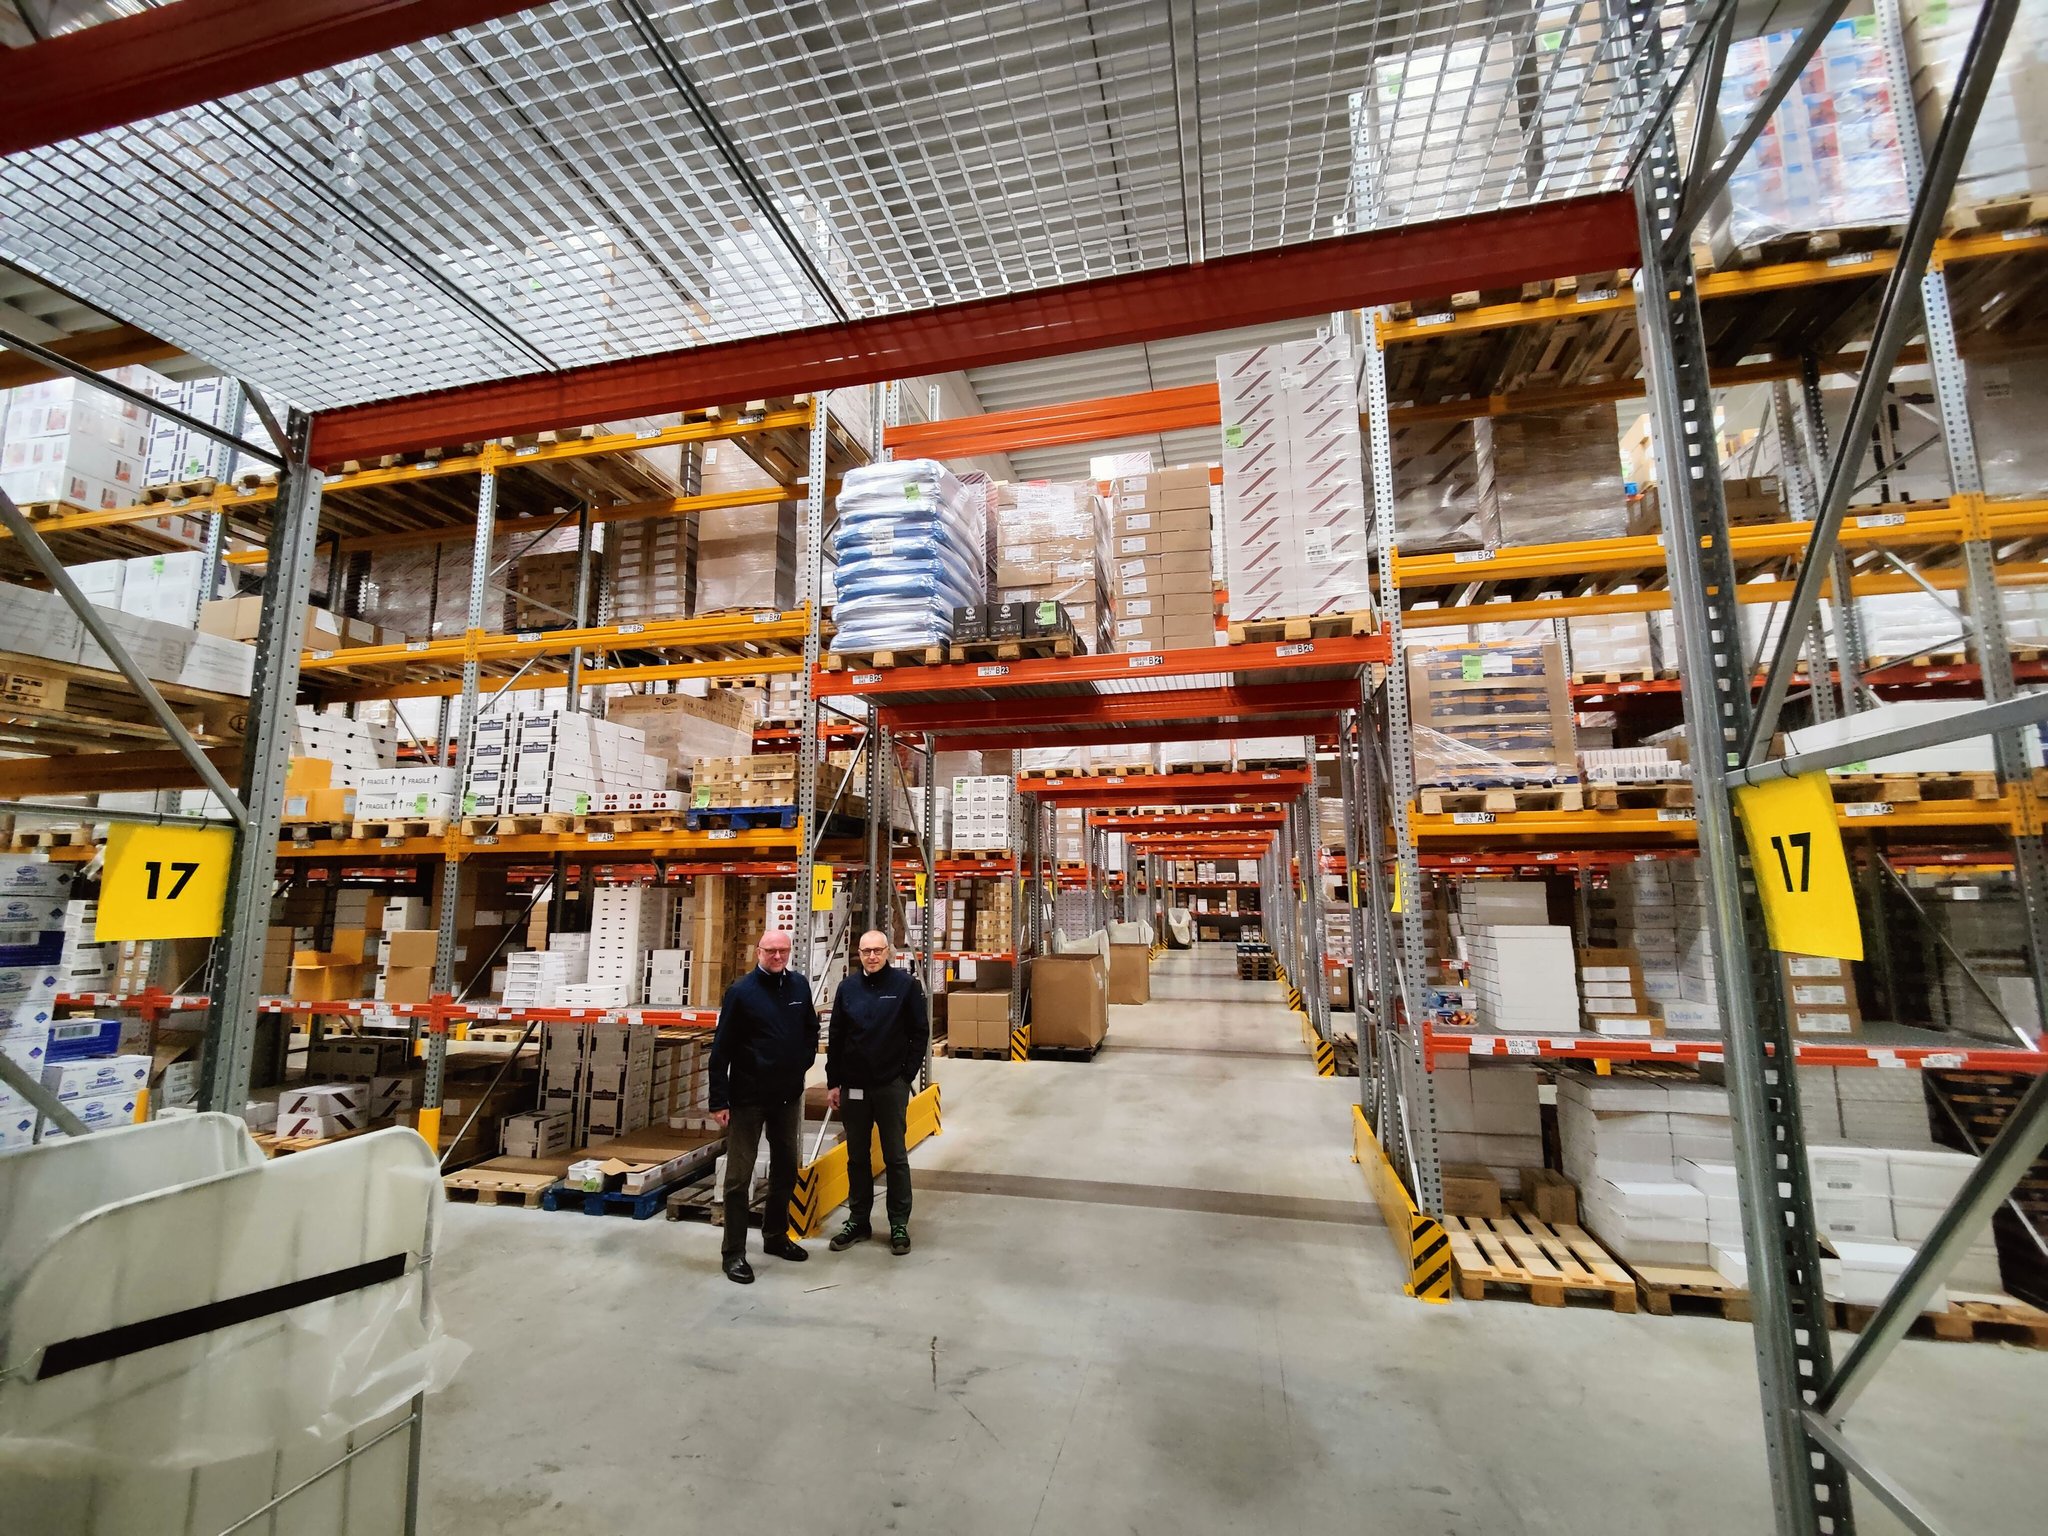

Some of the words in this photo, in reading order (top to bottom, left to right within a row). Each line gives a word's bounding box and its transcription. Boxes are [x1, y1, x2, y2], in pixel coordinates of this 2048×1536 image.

[367, 778, 389, 786] FRAGILE
[407, 777, 431, 785] FRAGILE
[1770, 832, 1811, 892] 17
[145, 861, 201, 900] 17
[816, 879, 827, 895] 17
